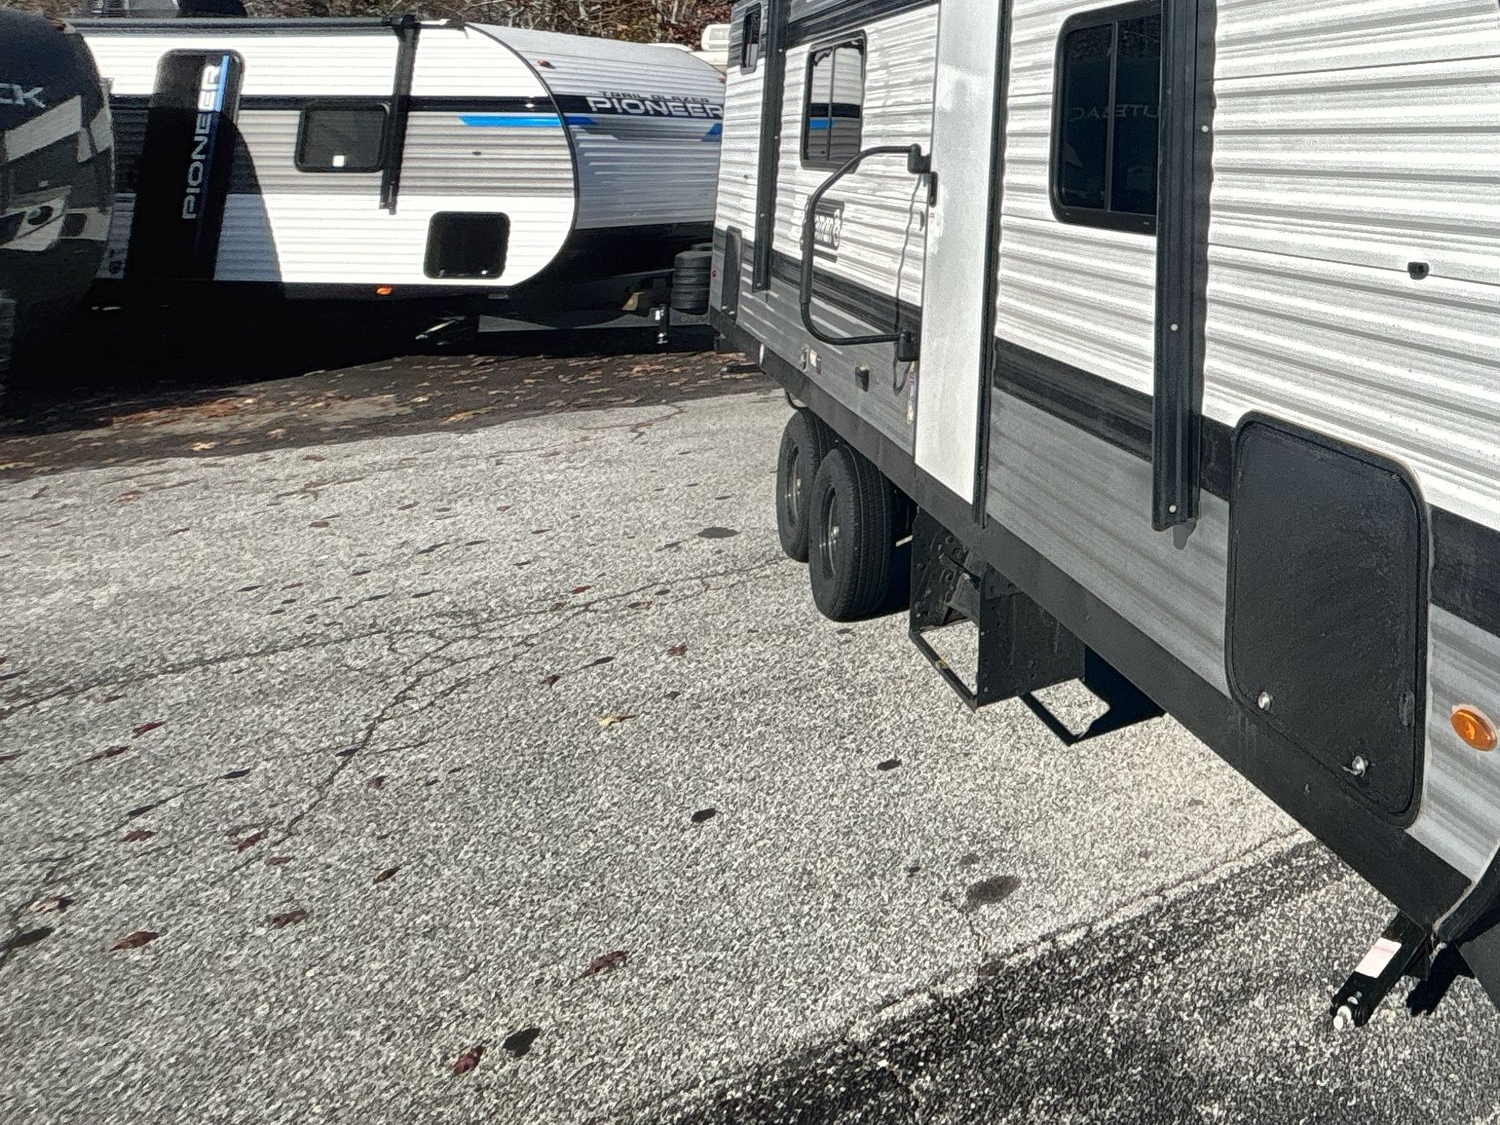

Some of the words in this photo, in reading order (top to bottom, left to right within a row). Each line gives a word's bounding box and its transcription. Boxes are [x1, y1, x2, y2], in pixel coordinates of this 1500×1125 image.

[585, 96, 725, 118] PIONEER
[599, 90, 648, 100] TRAIL
[650, 94, 710, 104] BLAZER
[181, 63, 221, 220] PIONEER
